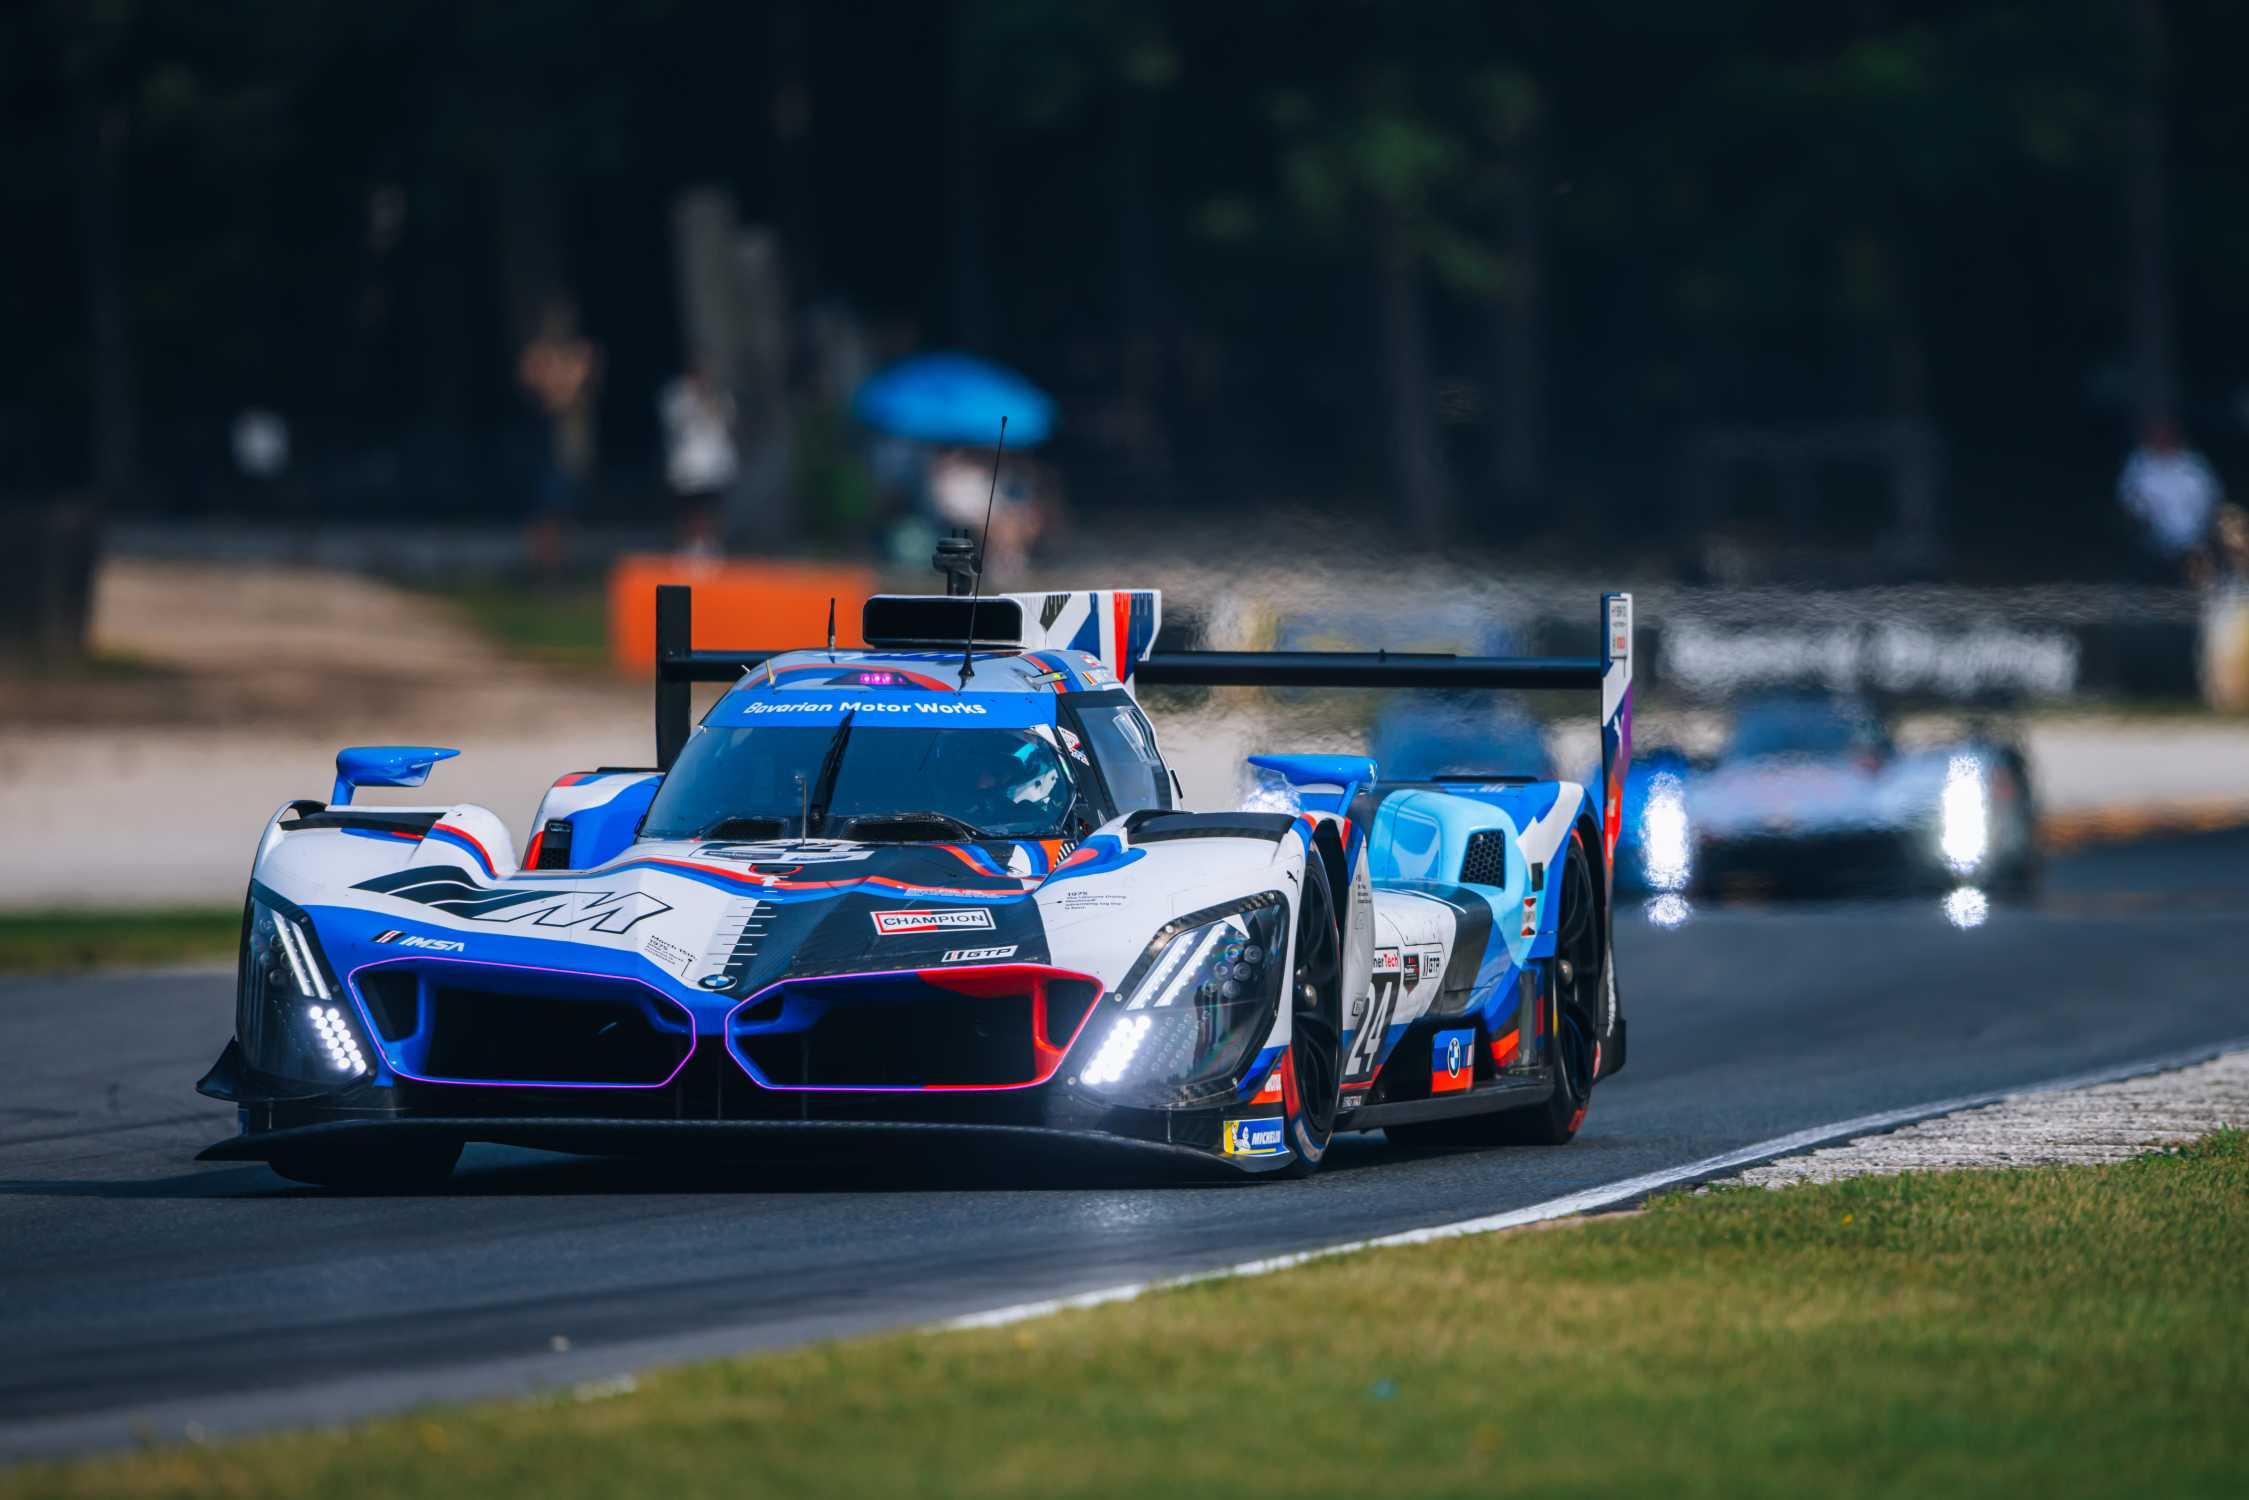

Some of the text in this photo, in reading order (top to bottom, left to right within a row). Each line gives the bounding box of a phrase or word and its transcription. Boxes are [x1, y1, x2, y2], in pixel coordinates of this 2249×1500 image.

[743, 702, 988, 715] Bavarian Motor Works
[883, 913, 985, 926] CHAMPION
[398, 936, 465, 952] IMSA
[967, 947, 1012, 958] GTP
[1373, 953, 1399, 968] nerTech
[1345, 982, 1392, 1075] 24
